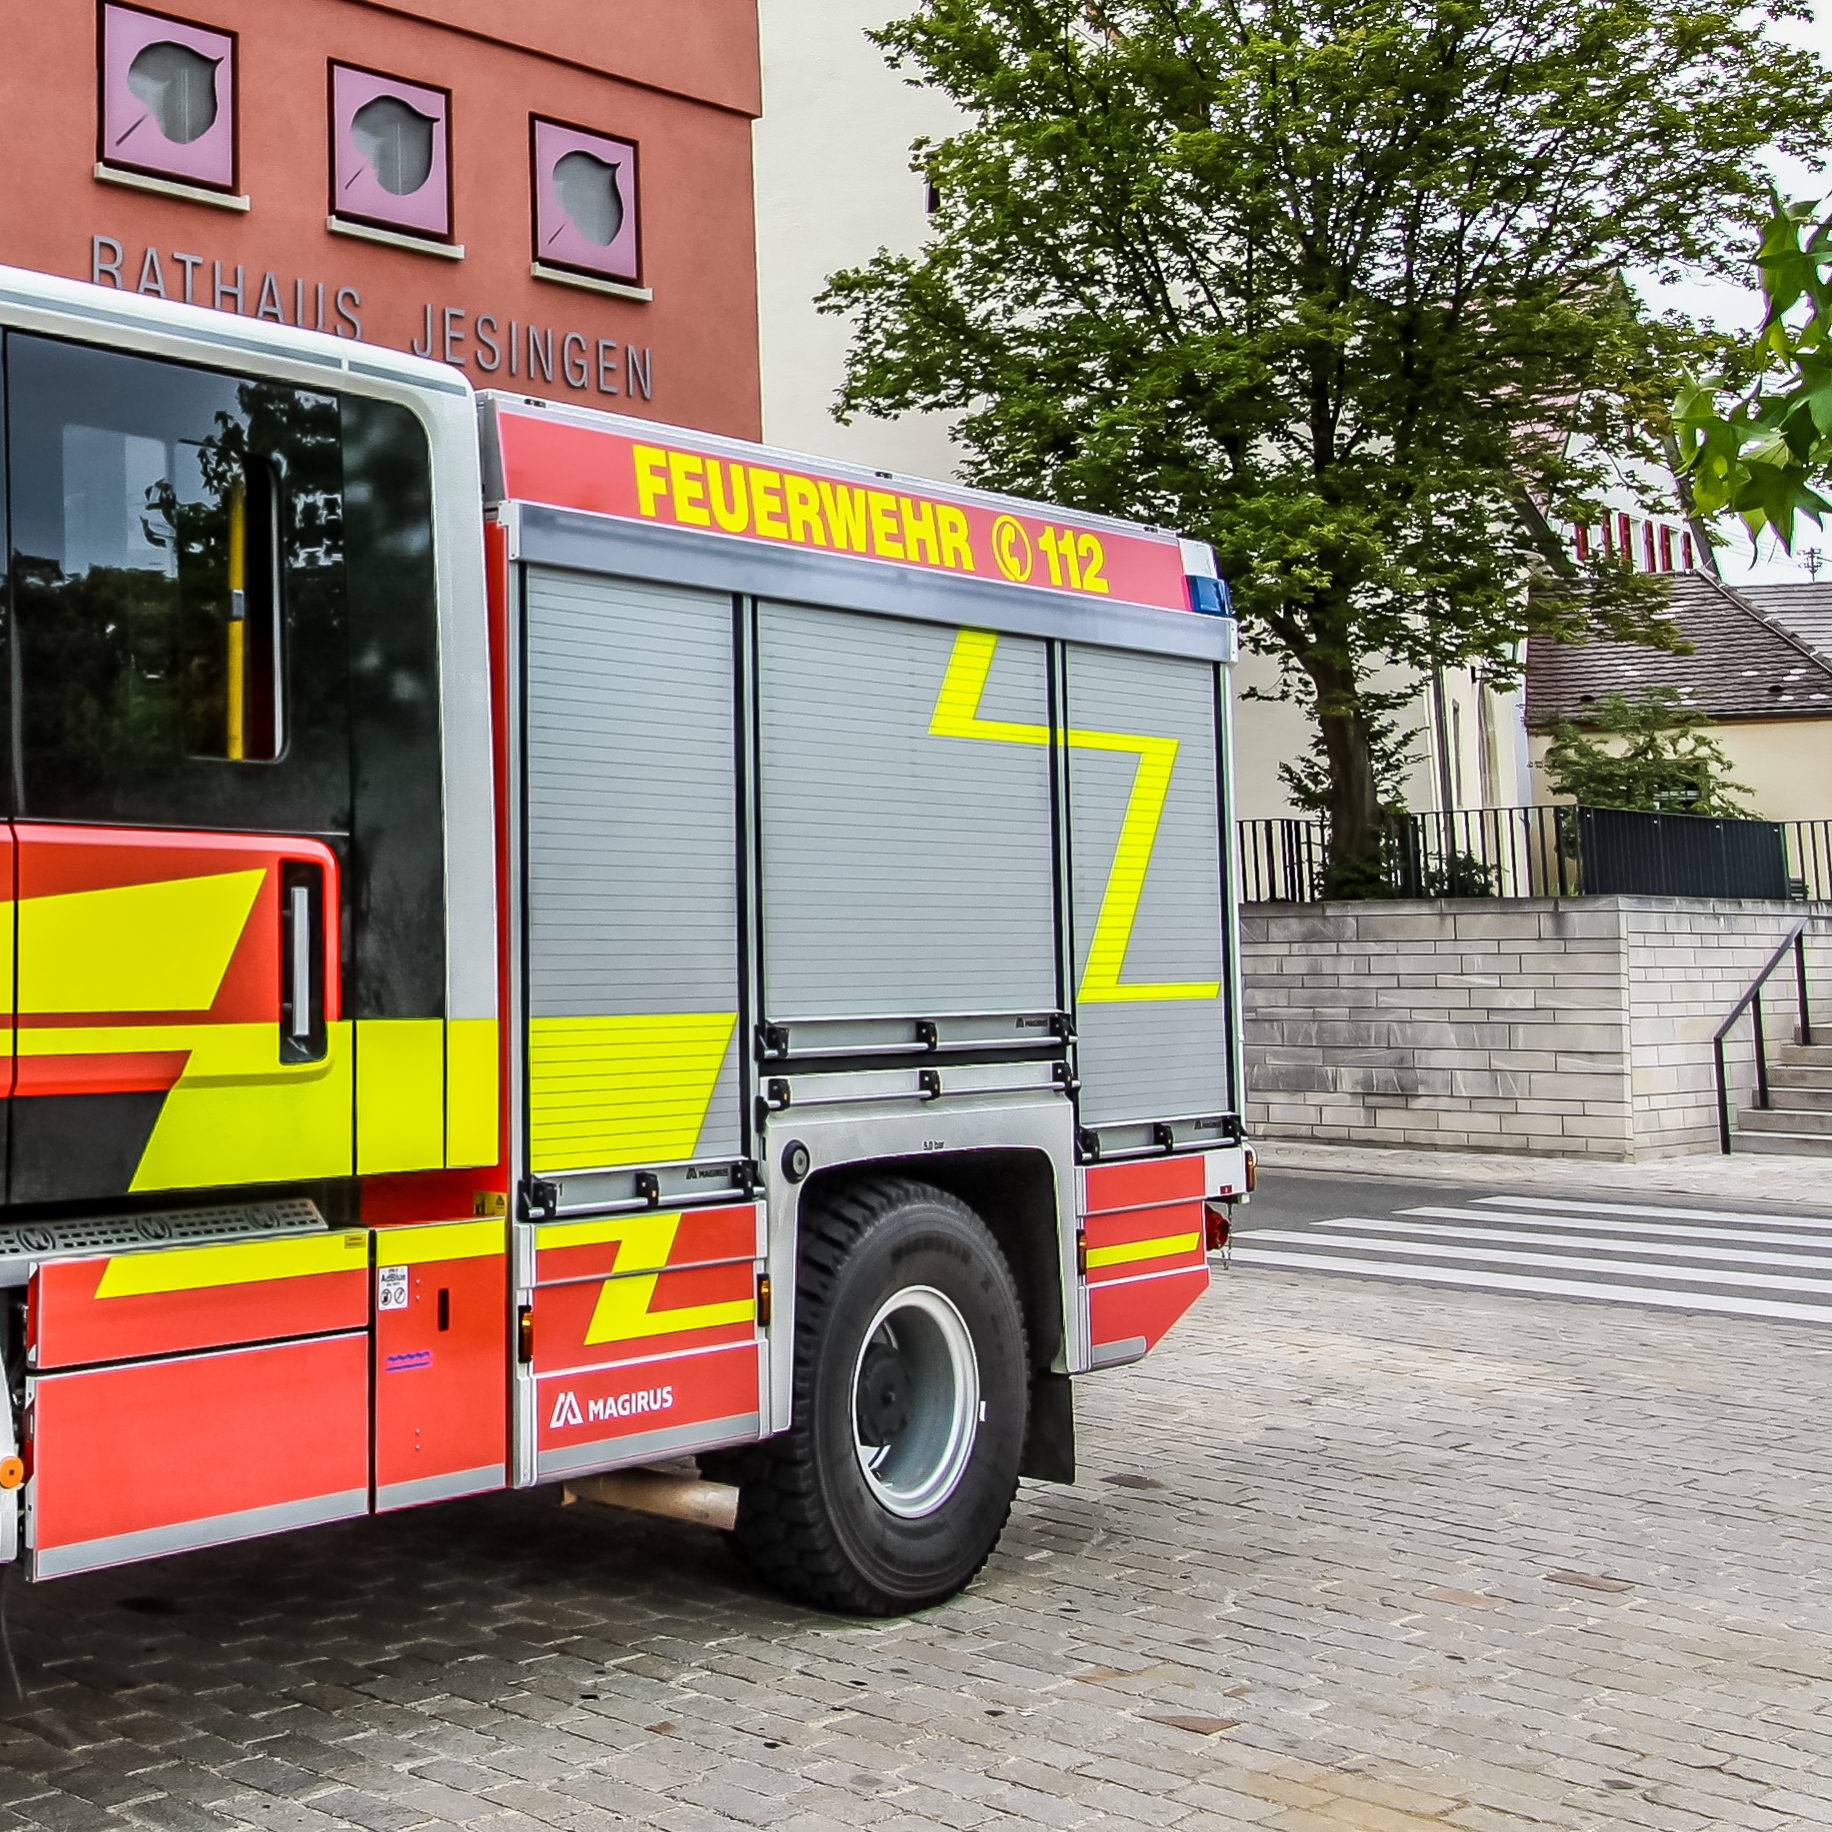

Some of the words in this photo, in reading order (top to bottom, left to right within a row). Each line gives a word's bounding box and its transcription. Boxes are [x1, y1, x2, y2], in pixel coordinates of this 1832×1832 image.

[91, 234, 363, 341] RATHAUS
[412, 303, 653, 400] JESINGEN
[632, 444, 976, 572] FEUERWEHR
[1037, 526, 1111, 594] 112
[588, 1385, 673, 1422] MAGIRUS
